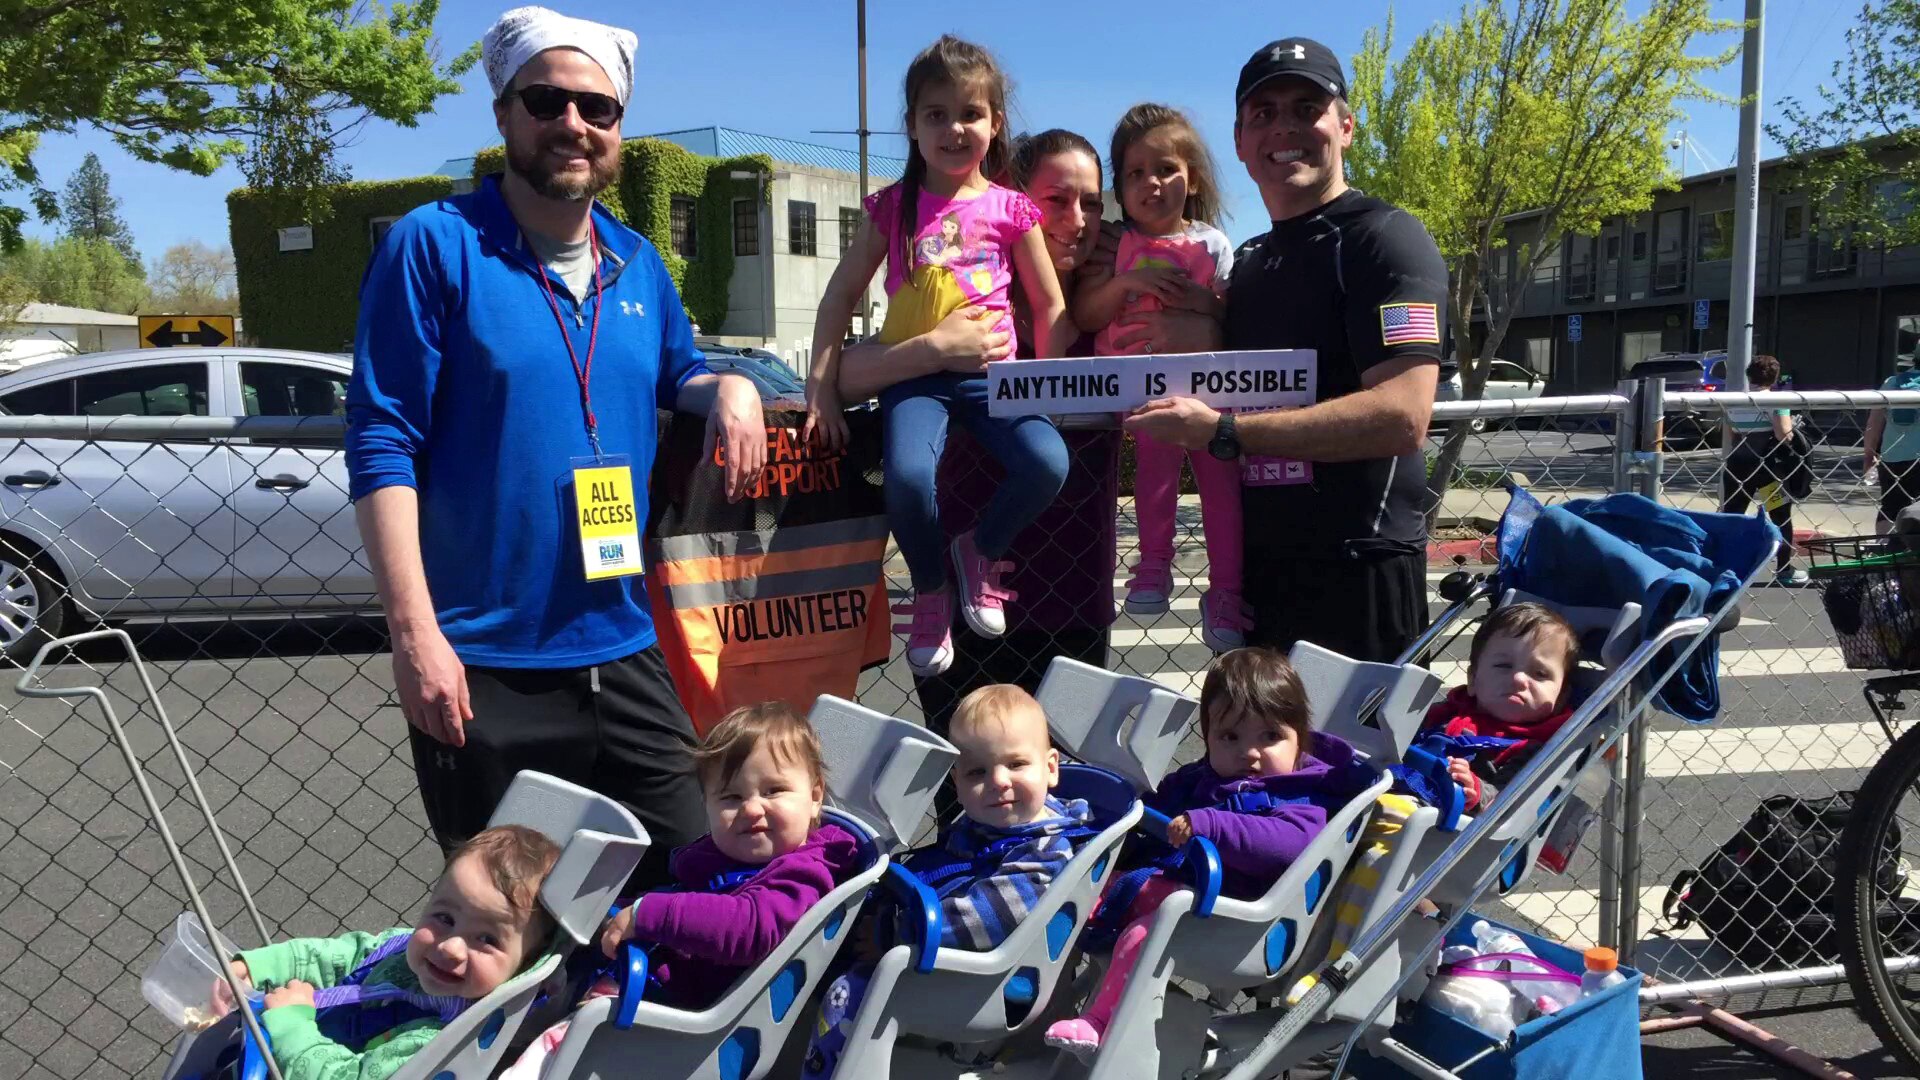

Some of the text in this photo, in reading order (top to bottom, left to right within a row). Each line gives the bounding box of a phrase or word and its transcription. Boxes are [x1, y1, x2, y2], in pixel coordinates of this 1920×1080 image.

[996, 369, 1308, 401] ANYTHING IS POSSIBLE
[744, 456, 841, 499] UPPORT
[591, 481, 619, 503] ALL
[582, 504, 633, 527] ACCESS
[599, 544, 624, 560] RUN
[712, 589, 867, 645] VOLUNTEER
